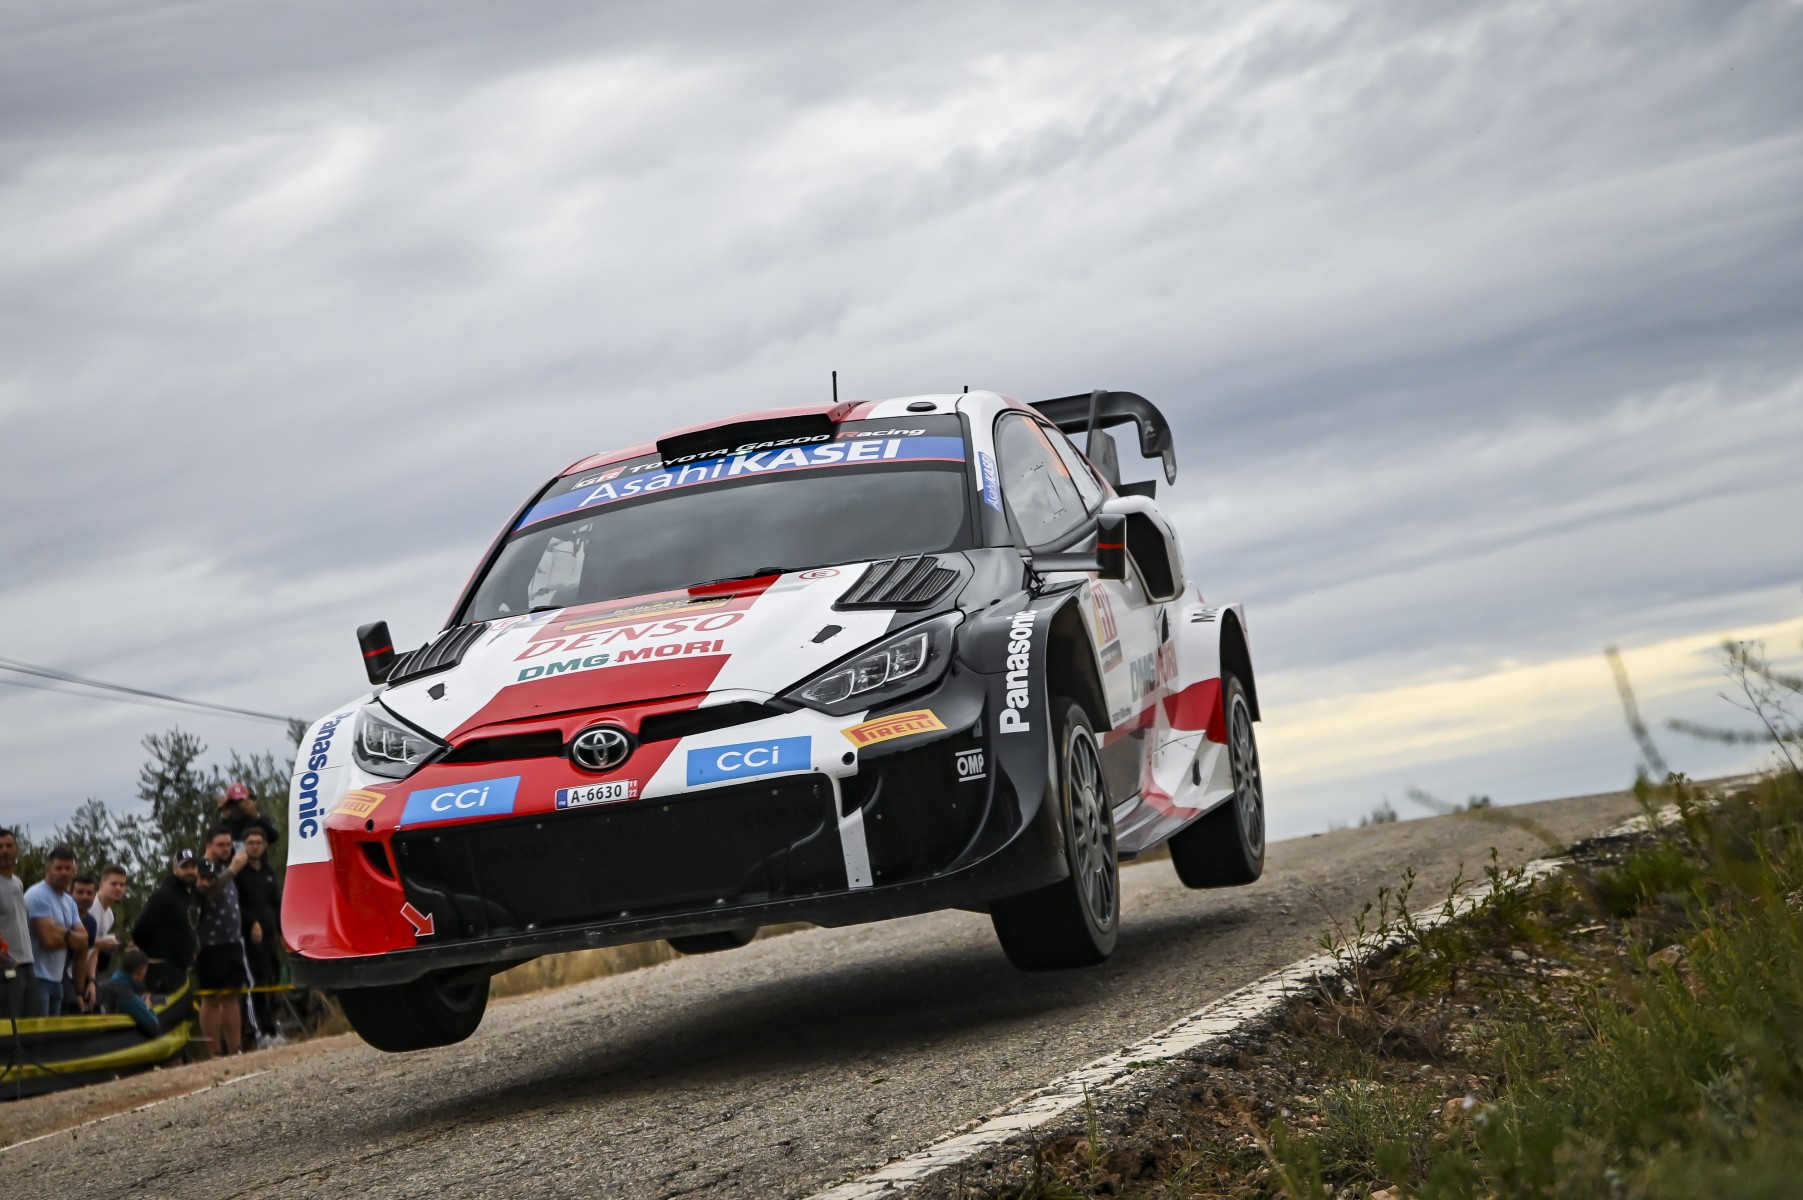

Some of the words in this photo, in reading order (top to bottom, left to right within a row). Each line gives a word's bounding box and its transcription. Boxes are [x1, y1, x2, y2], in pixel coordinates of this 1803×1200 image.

[629, 448, 729, 474] TOYOTA
[734, 433, 831, 453] GAZOO
[835, 428, 927, 440] Racing
[513, 612, 745, 662] DENSO
[517, 653, 610, 682] DMG
[617, 639, 725, 663] MORI
[999, 609, 1040, 734] Panasonic
[850, 713, 938, 743] PIRELLI
[298, 710, 357, 839] Panasonic
[956, 753, 985, 776] OMP
[570, 784, 623, 804] A-6630
